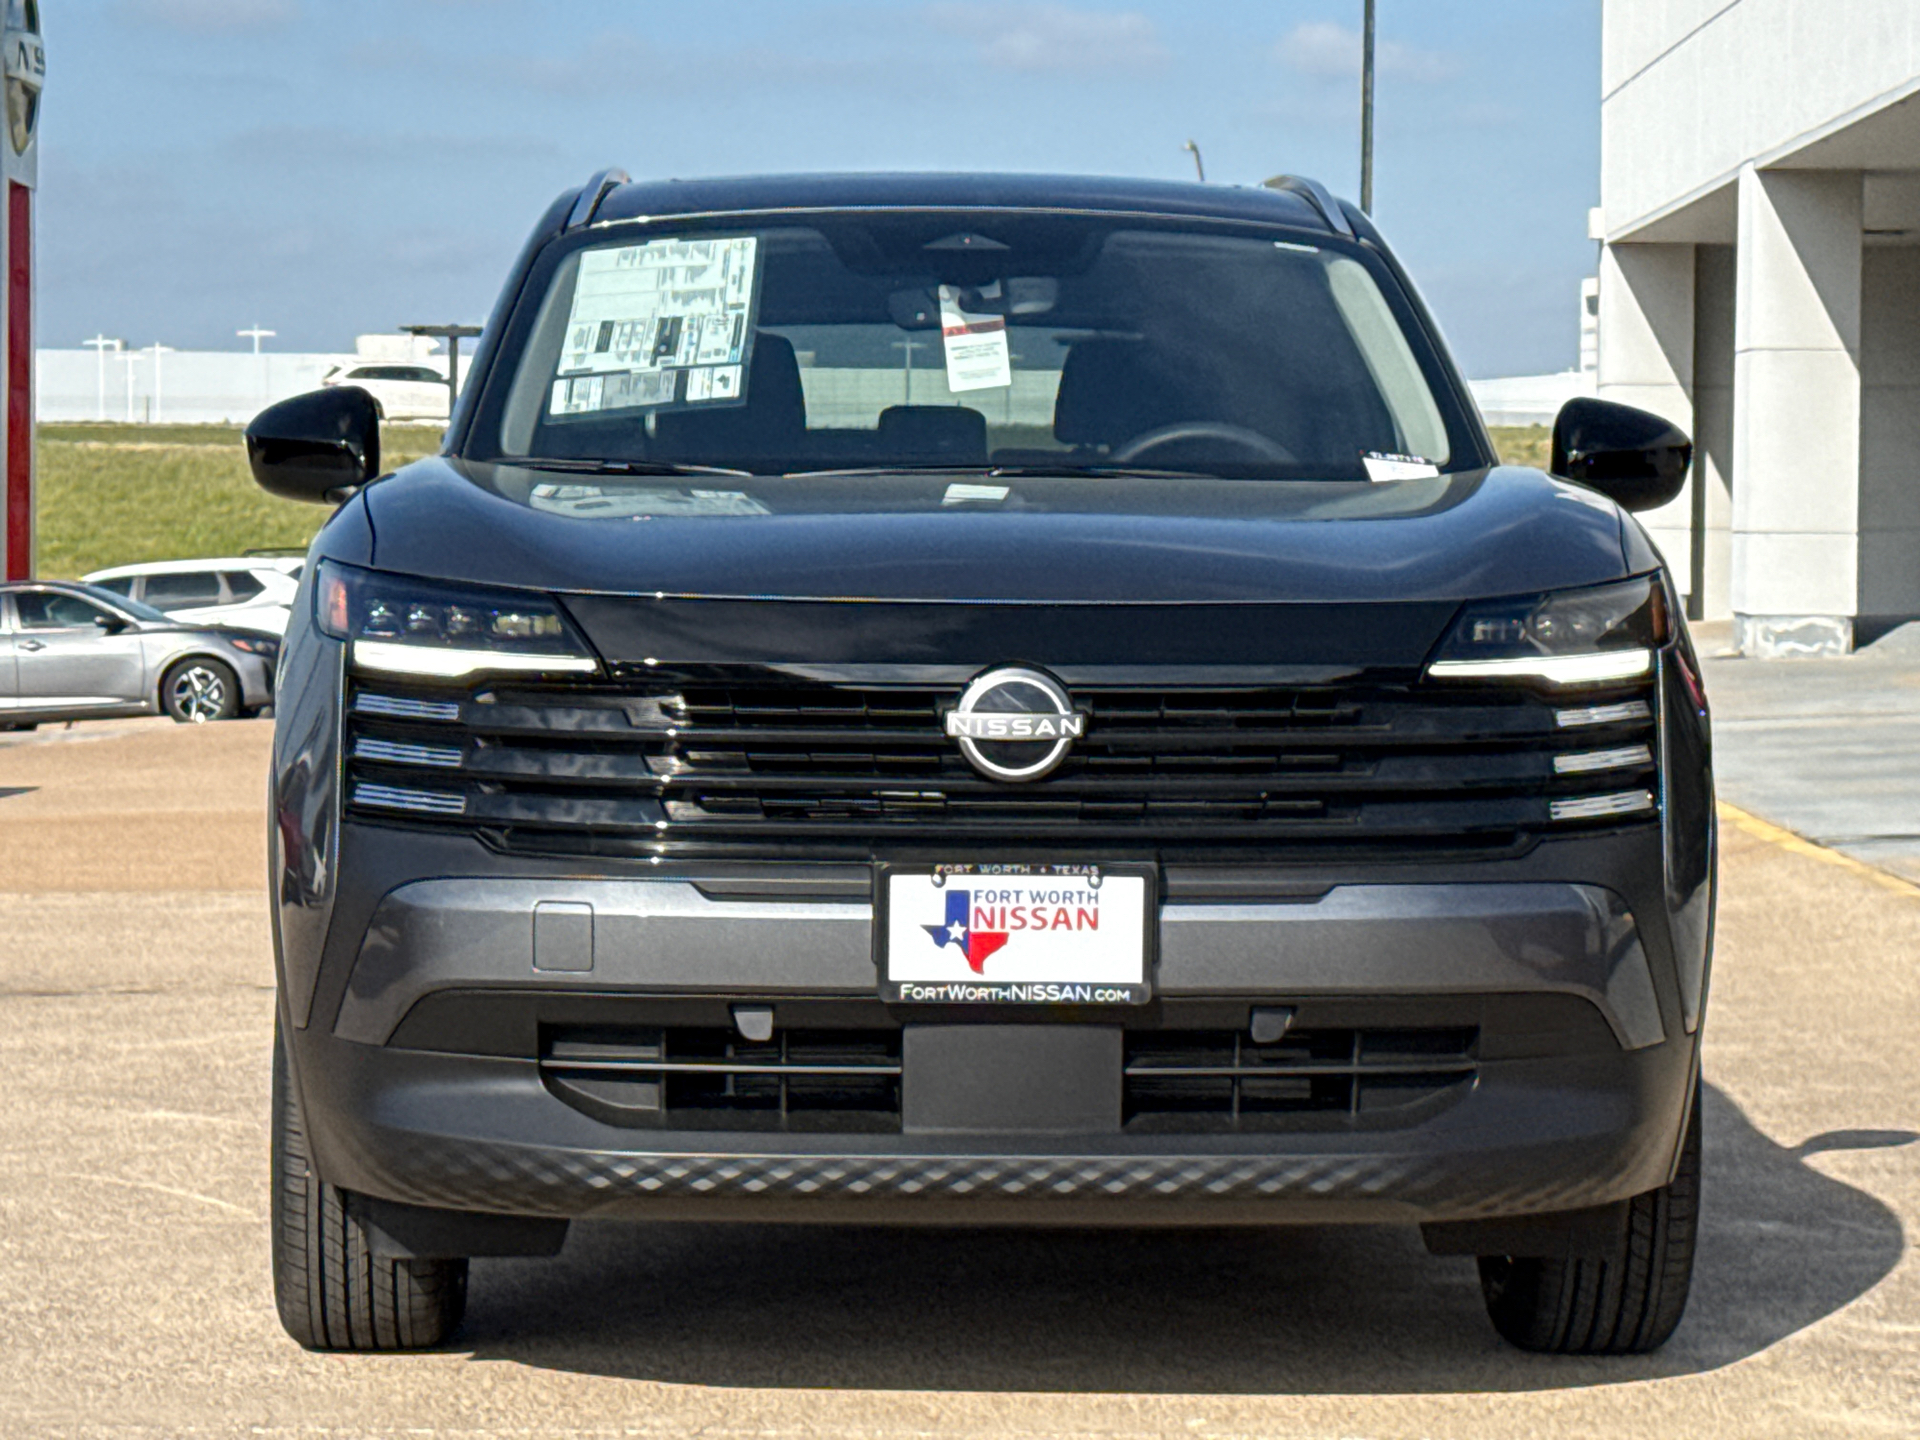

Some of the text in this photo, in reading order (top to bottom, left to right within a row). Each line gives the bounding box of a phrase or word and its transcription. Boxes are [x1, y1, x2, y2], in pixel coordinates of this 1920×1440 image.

[950, 717, 1081, 736] NISSAN
[934, 864, 1099, 875] FORT WORTH TEXAS
[974, 890, 1099, 905] FORT WORTH
[974, 906, 1099, 931] NISSAN
